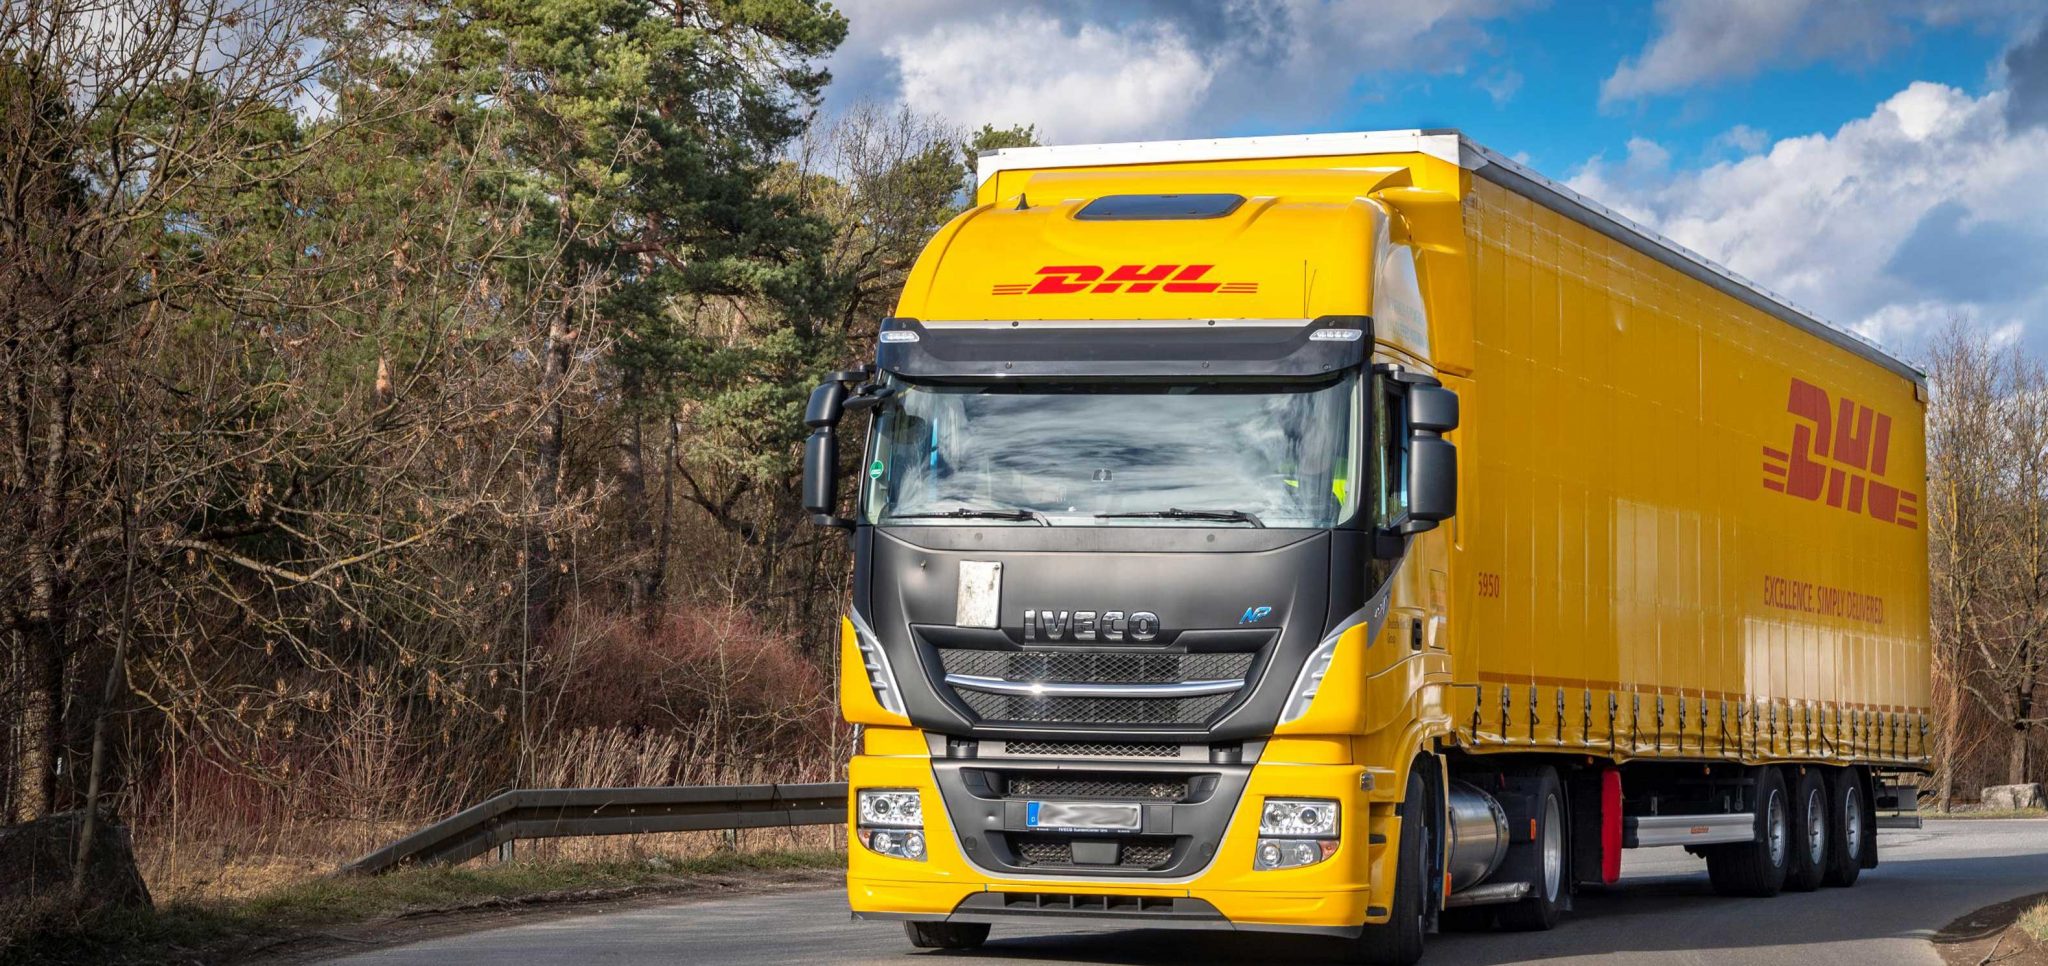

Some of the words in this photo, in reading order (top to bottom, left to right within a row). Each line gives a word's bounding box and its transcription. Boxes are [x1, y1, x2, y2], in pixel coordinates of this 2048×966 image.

[1026, 264, 1223, 295] DHL
[1786, 377, 1899, 523] DHL
[1764, 576, 1815, 612] EXCELLENCE.
[1817, 586, 1845, 616] SIMPLY
[1024, 610, 1159, 641] IVECO
